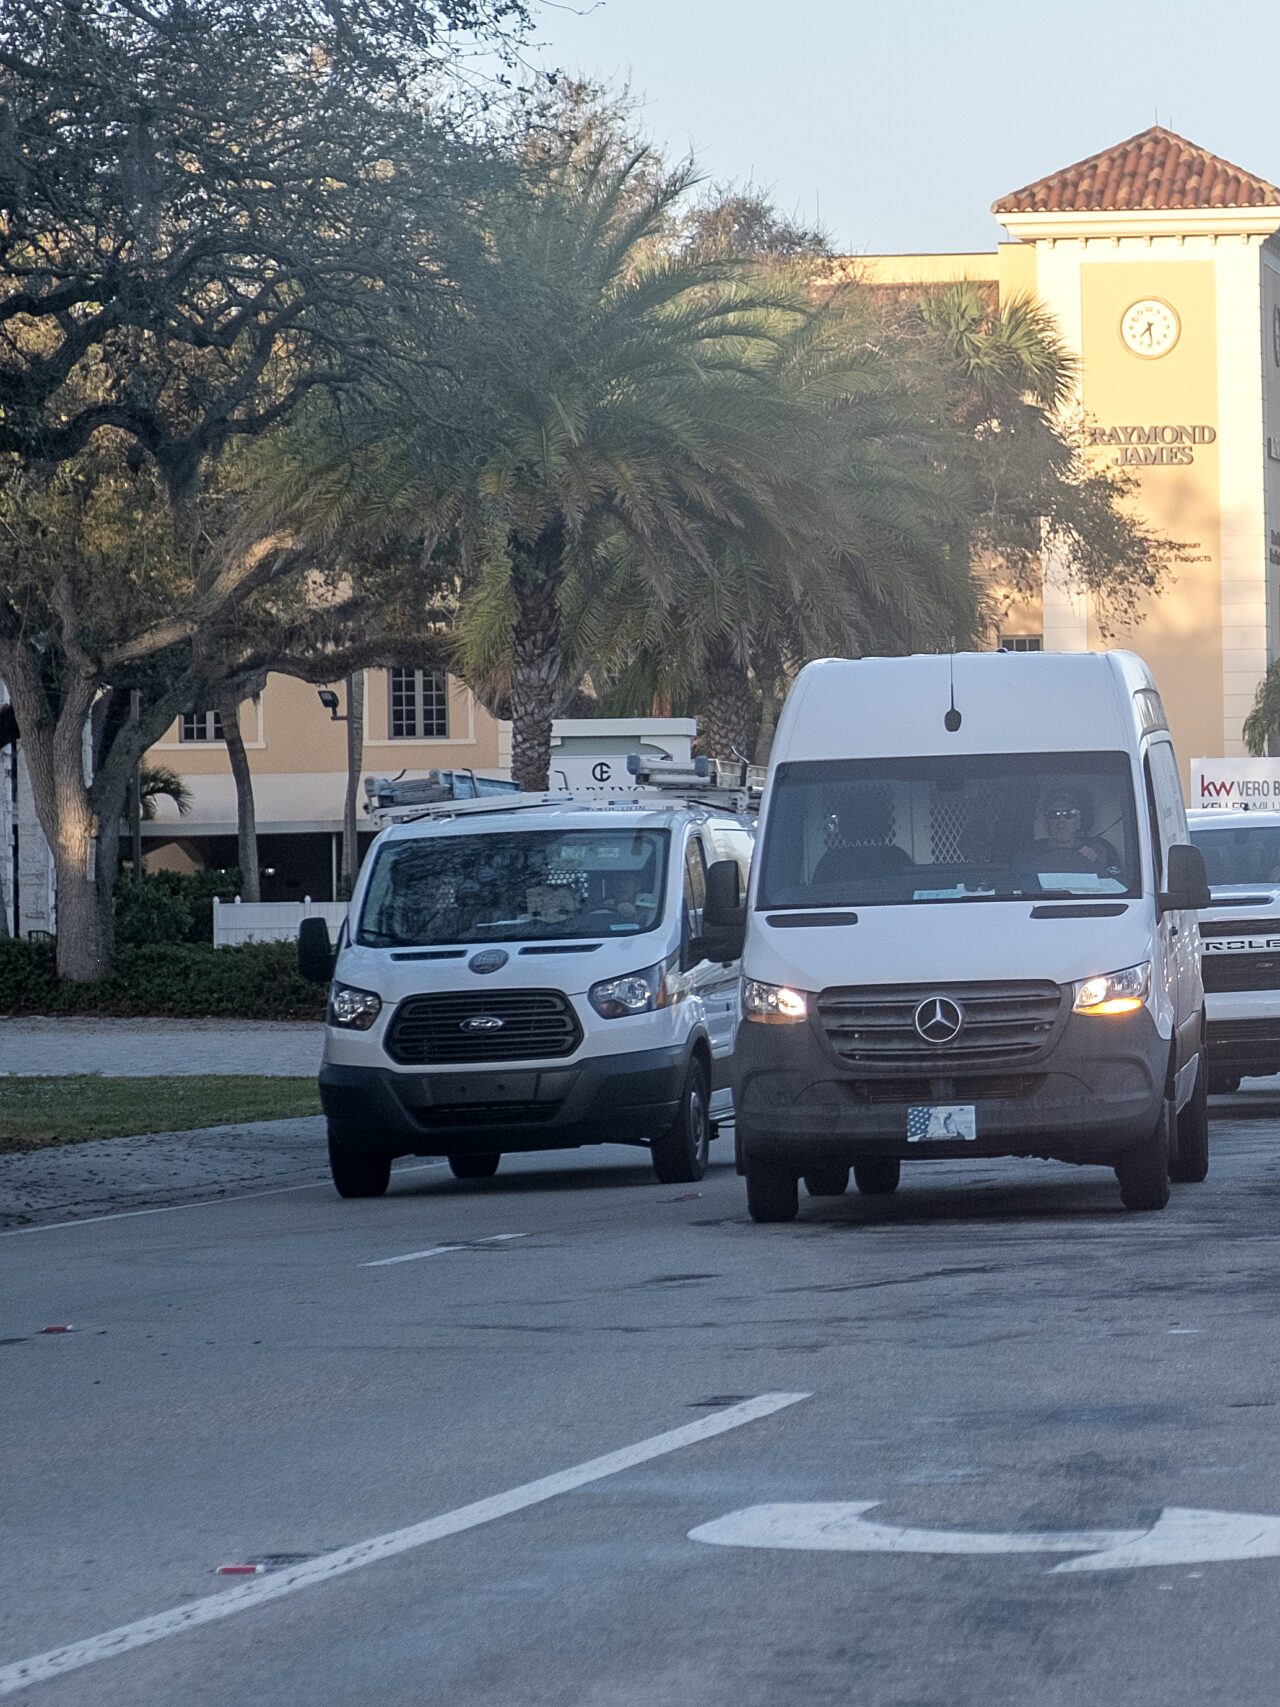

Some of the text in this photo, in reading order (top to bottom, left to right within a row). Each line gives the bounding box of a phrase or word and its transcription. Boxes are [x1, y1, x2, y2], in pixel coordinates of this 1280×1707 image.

[1088, 425, 1217, 446] RAYMOND
[1111, 446, 1194, 466] JAMES
[1201, 774, 1234, 797] kw
[1238, 780, 1270, 797] VERO
